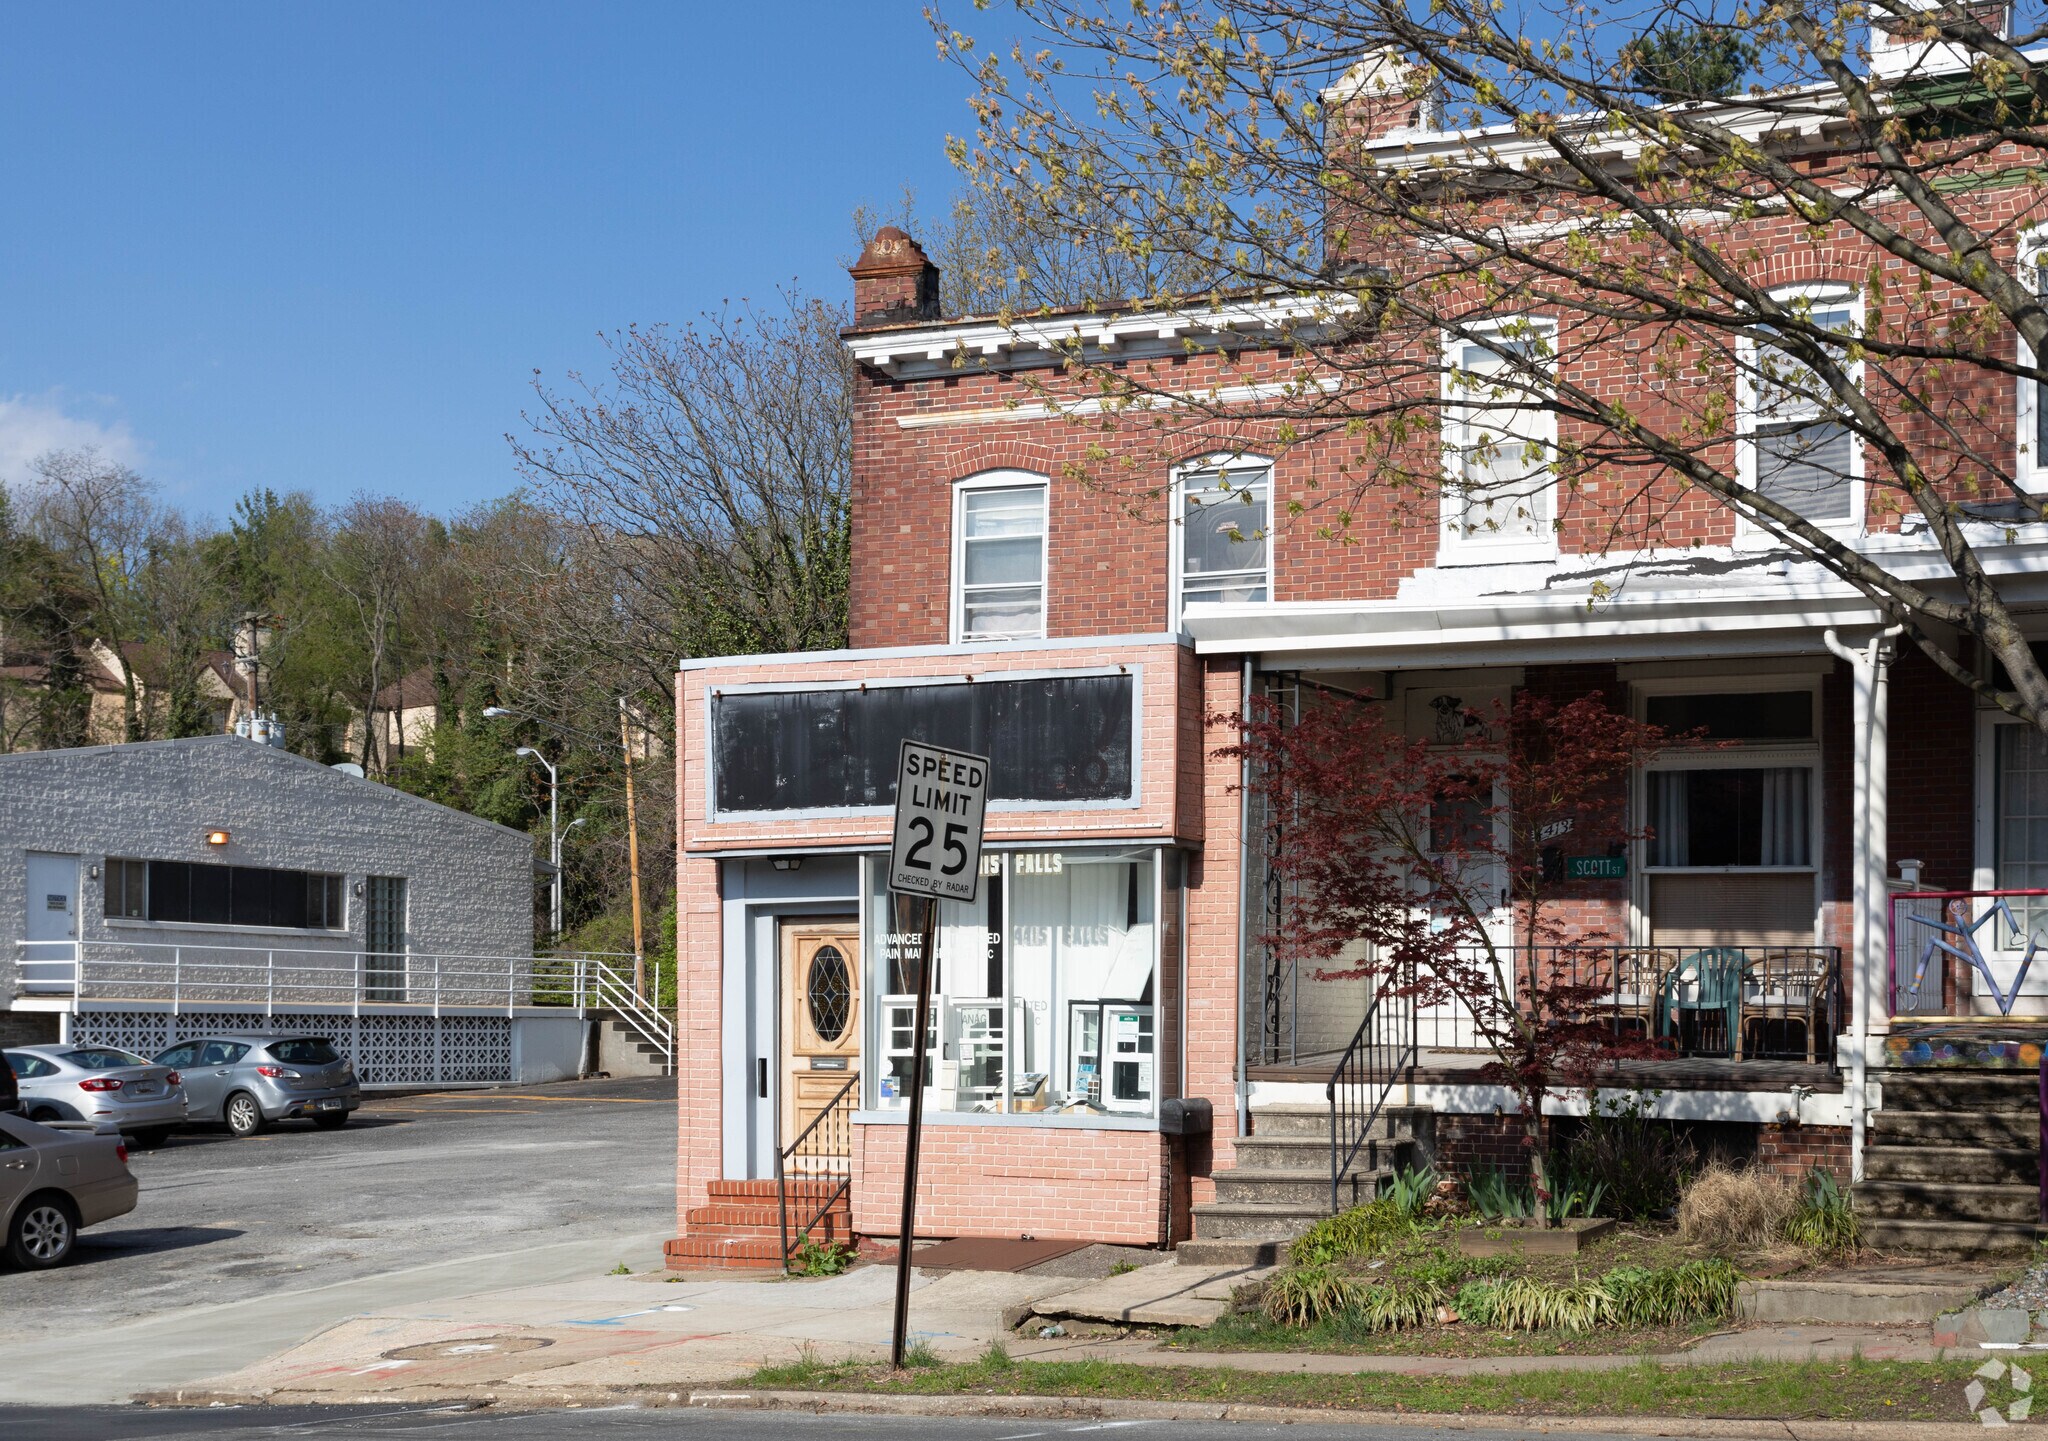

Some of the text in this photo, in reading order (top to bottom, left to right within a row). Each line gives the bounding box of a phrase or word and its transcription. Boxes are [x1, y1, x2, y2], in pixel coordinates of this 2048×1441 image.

[906, 753, 982, 788] SPEED
[912, 784, 972, 816] LIMIT
[904, 816, 968, 876] 25
[1015, 853, 1063, 874] FALLS
[1576, 859, 1621, 875] SCOTT ST
[897, 873, 970, 894] CHECKED BY RADAR
[880, 948, 901, 959] PAIN
